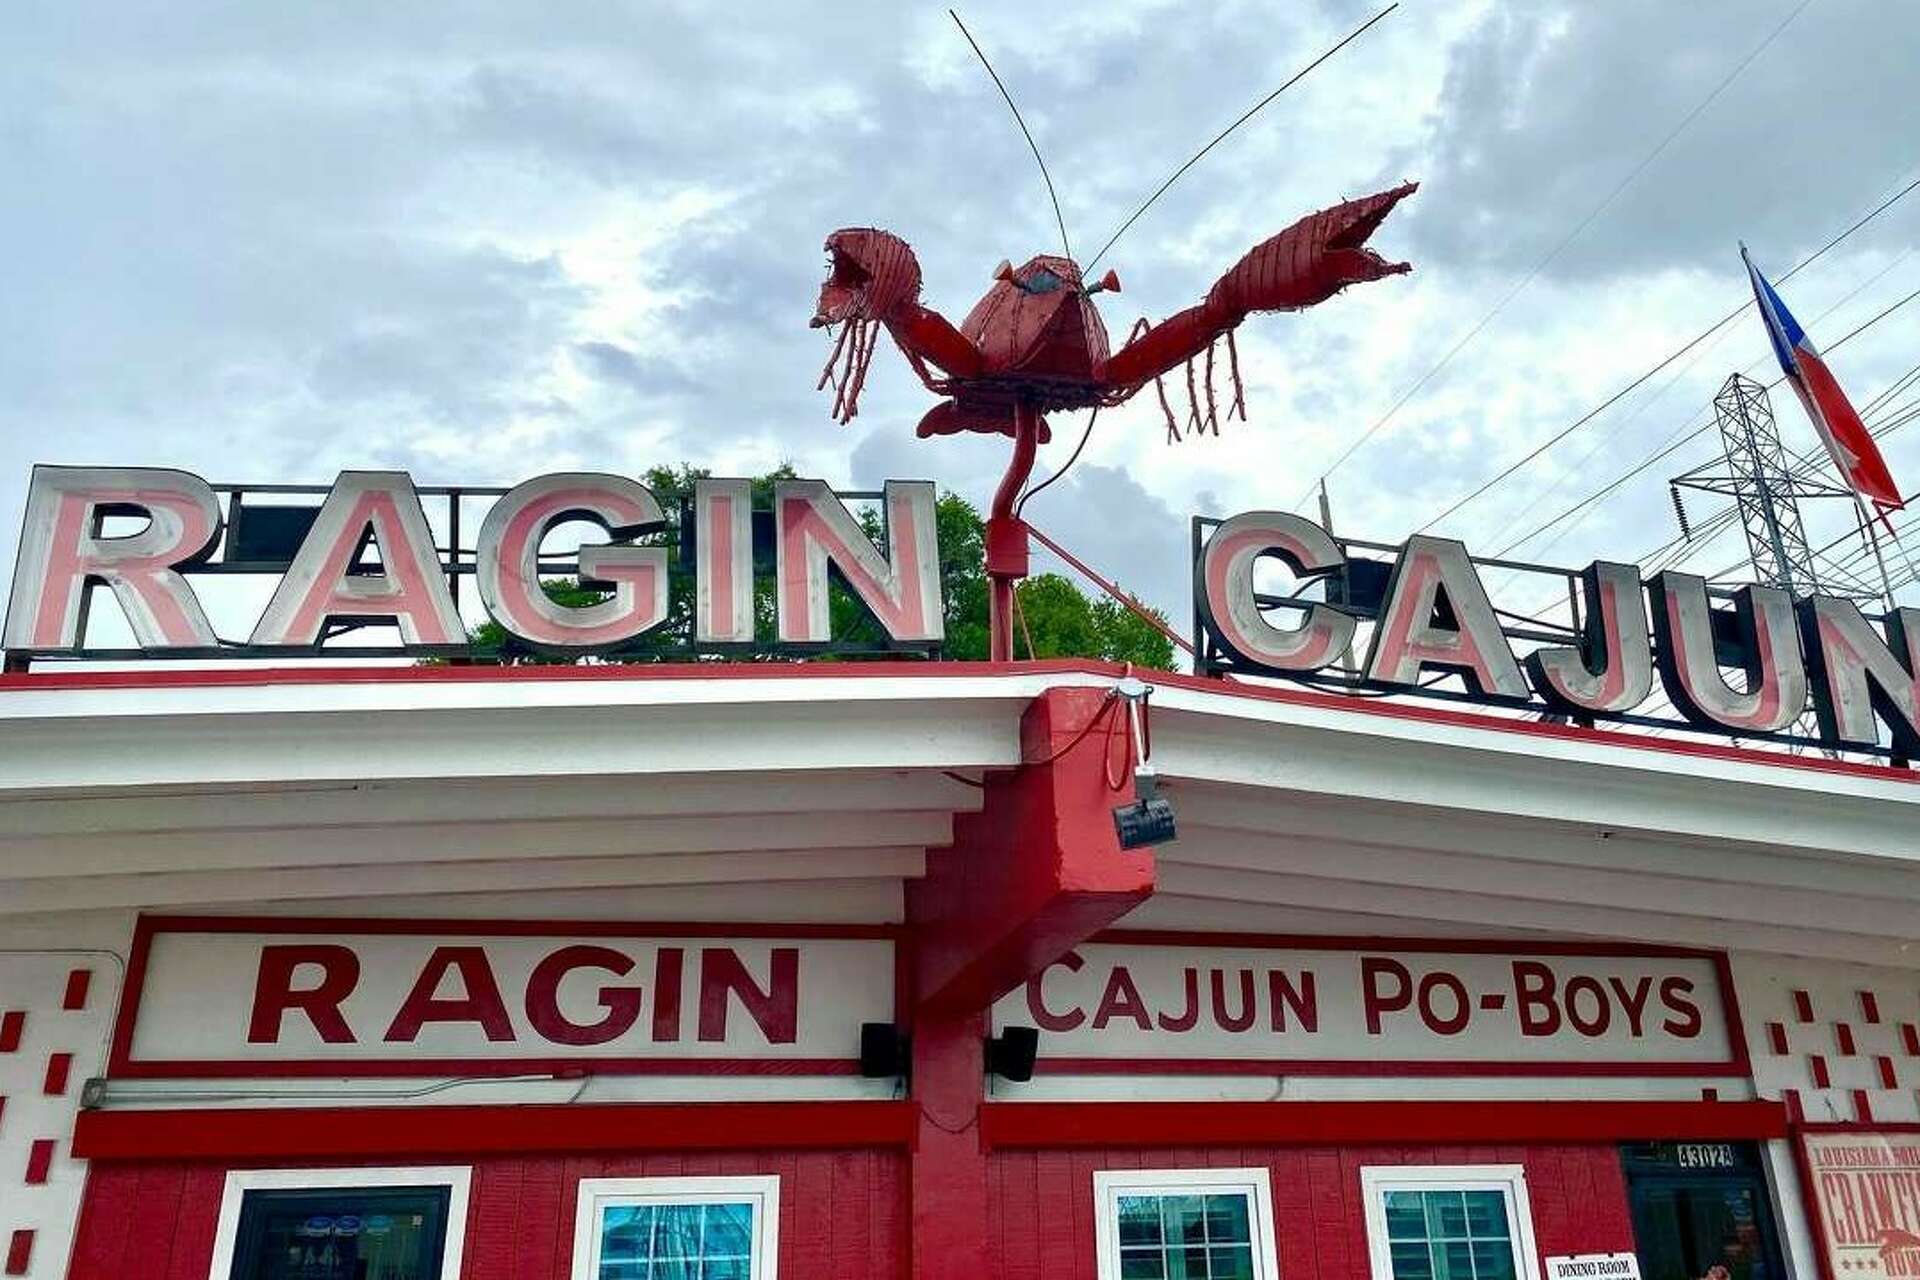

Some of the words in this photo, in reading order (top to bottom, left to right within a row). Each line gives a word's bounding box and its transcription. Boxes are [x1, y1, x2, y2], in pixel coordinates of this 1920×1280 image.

[4, 463, 946, 649] RAGIN
[1198, 510, 1920, 757] CAJUN
[247, 943, 799, 1046] RAGIN
[1026, 950, 1318, 1033] CAJUN
[1557, 1261, 1597, 1277] DINING
[1597, 1259, 1630, 1274] ROOM
